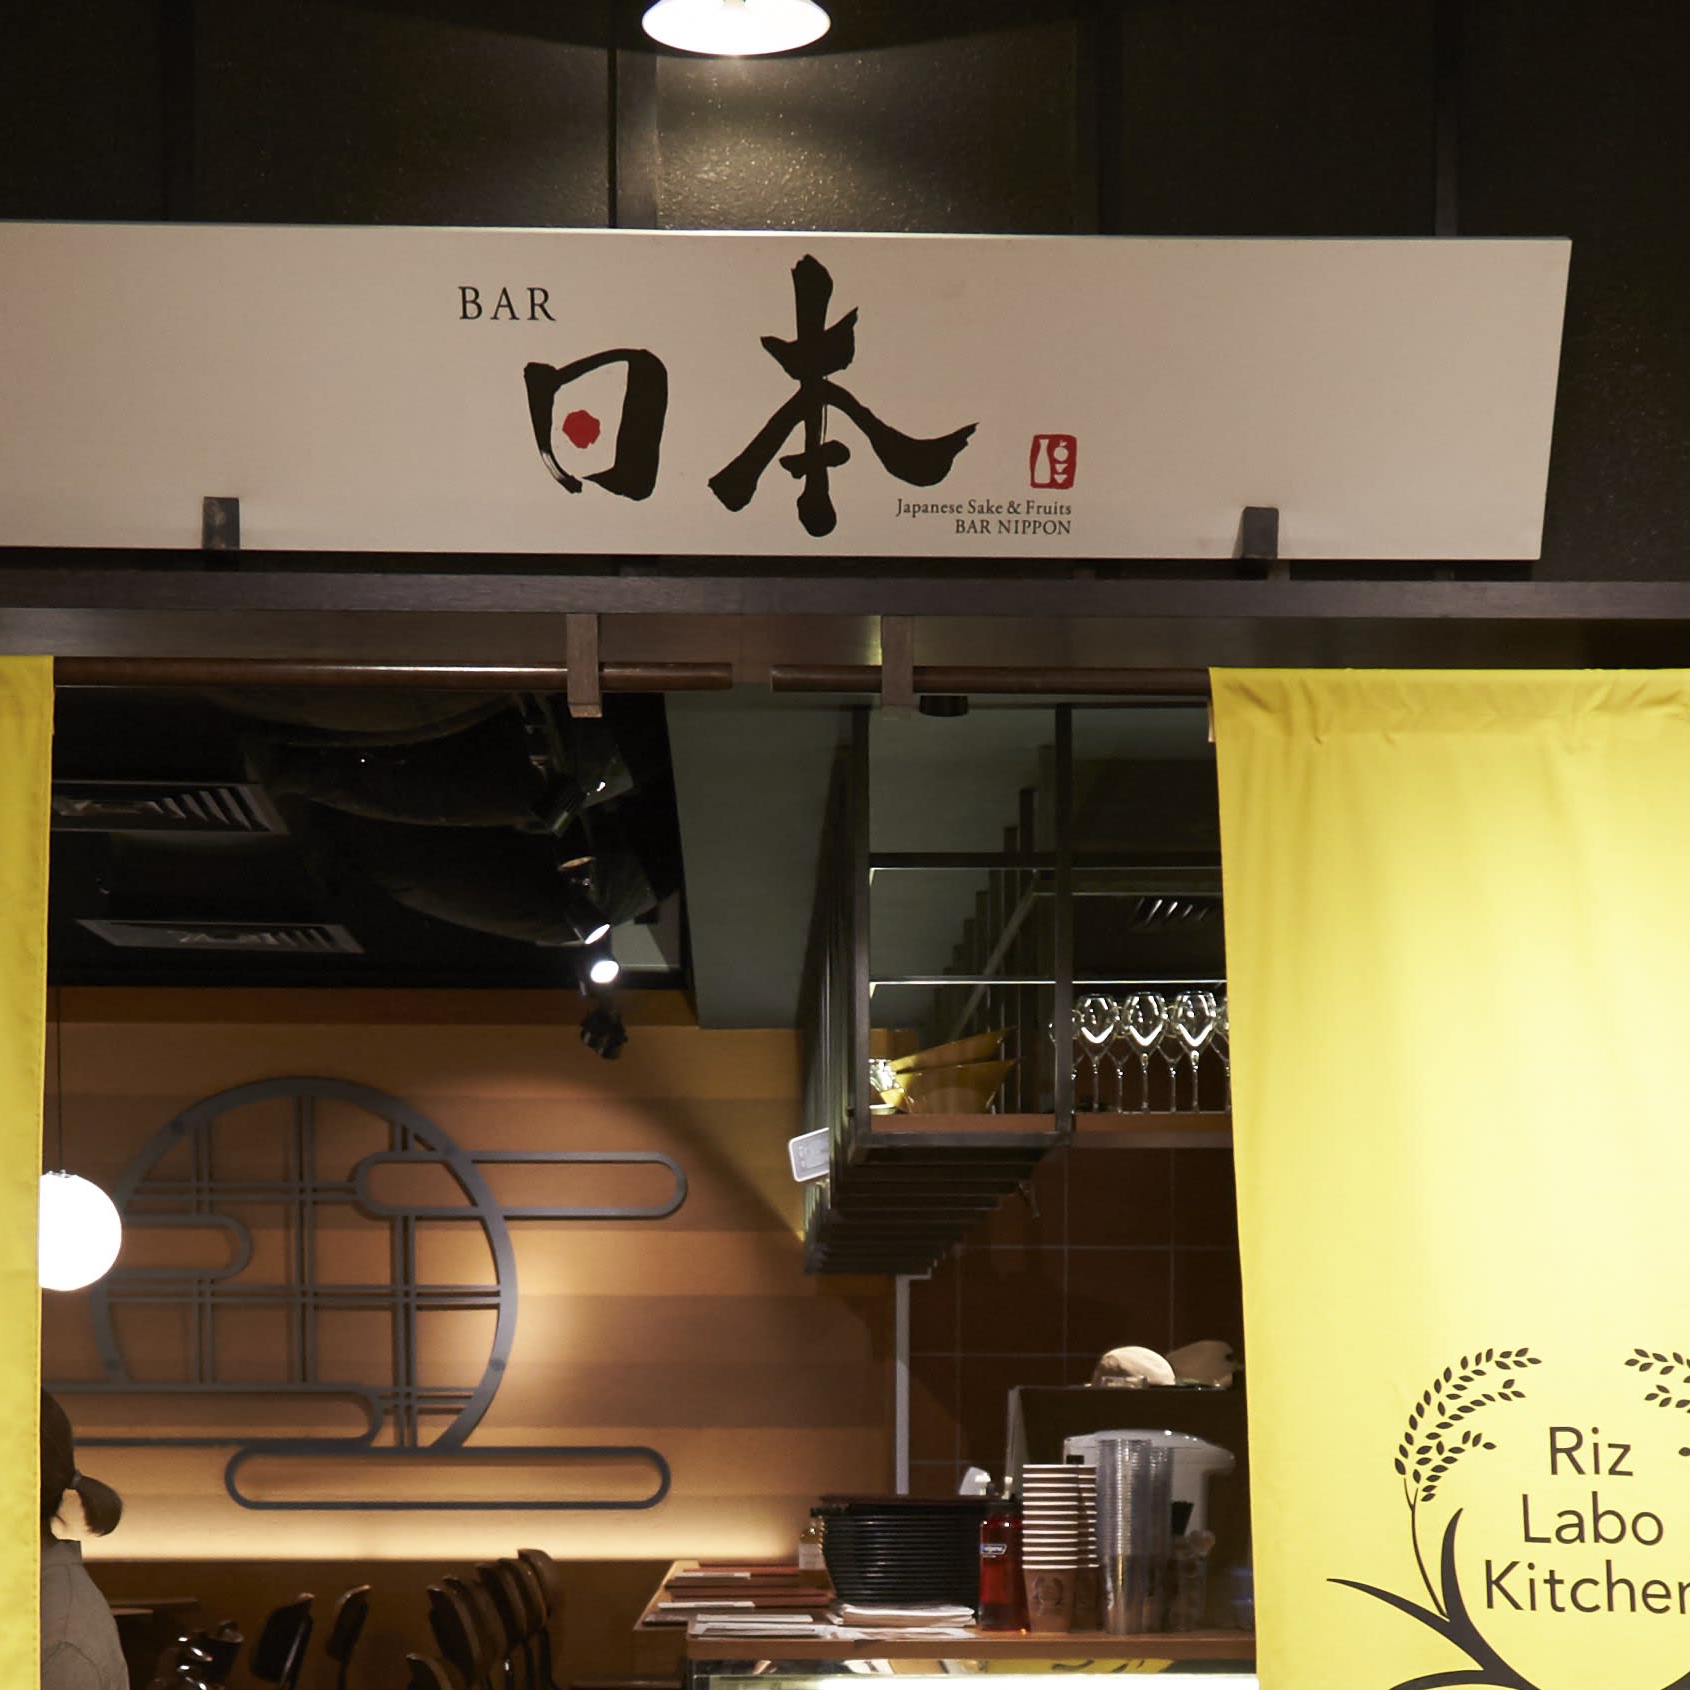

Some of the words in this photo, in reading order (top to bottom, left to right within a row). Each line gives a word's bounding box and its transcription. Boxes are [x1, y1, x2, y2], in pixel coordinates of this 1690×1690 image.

[458, 285, 557, 322] BAR
[523, 254, 980, 538] 日本
[896, 499, 963, 518] Japanese
[967, 500, 1003, 515] Sake
[1007, 501, 1022, 515] &
[1025, 501, 1073, 515] Fruits
[955, 519, 992, 535] BAR
[997, 519, 1072, 536] NIPPON
[1547, 1425, 1634, 1478] Riz
[1521, 1490, 1666, 1547] Labo
